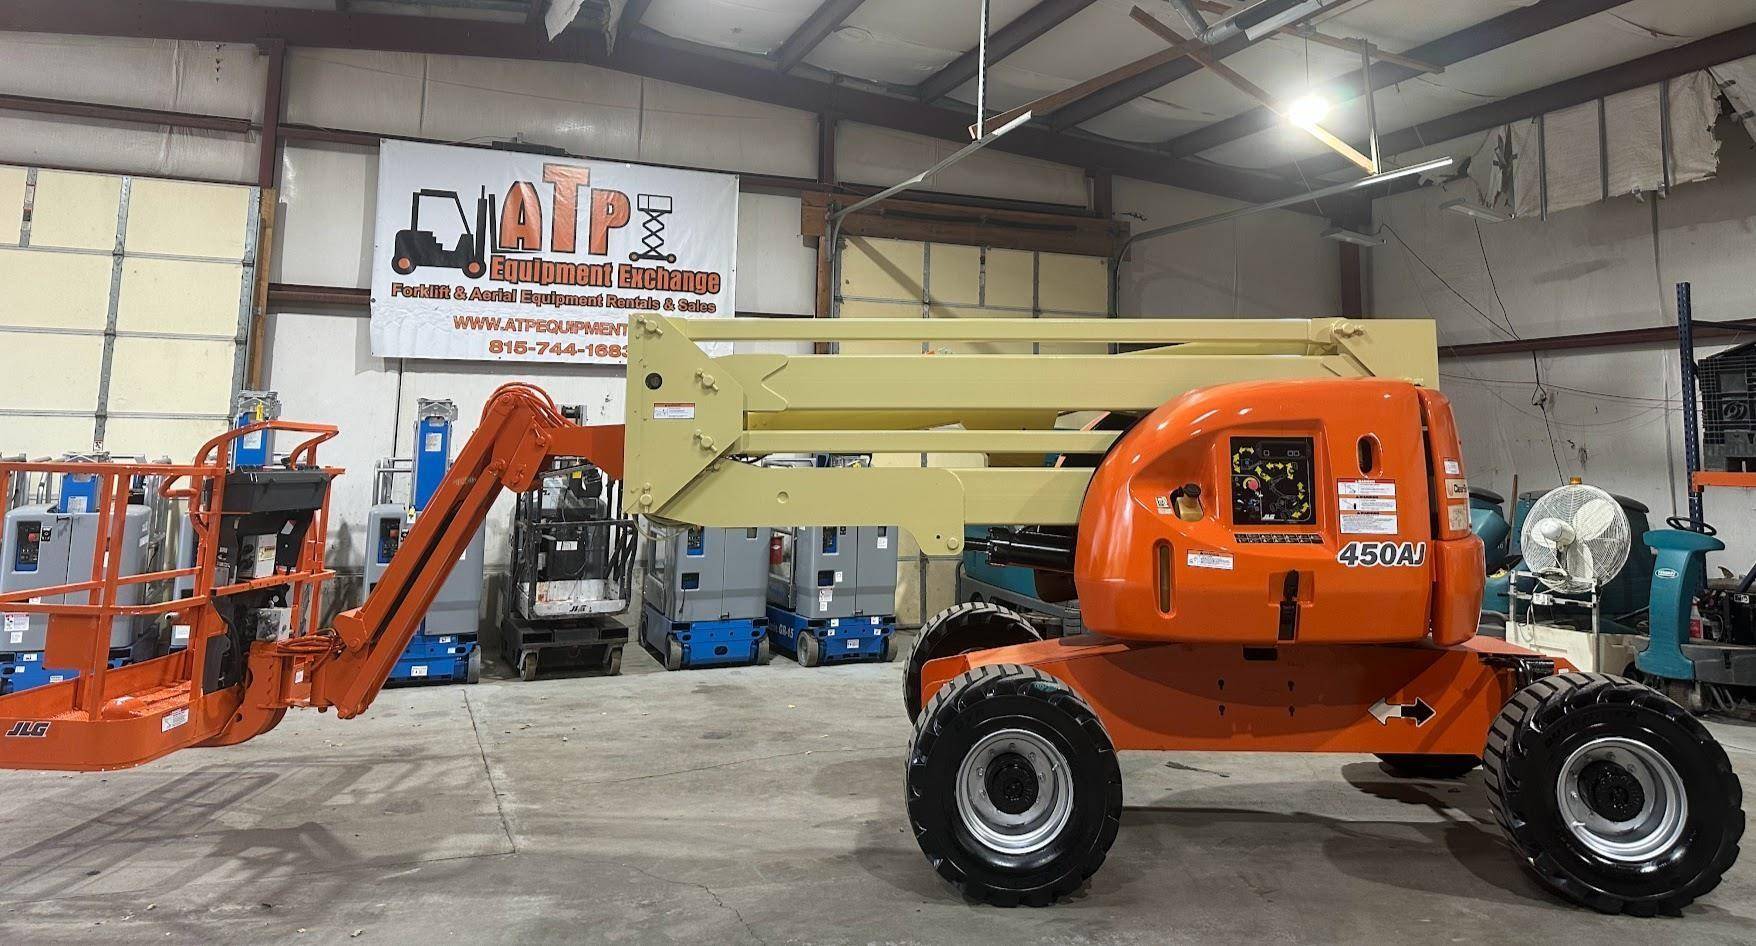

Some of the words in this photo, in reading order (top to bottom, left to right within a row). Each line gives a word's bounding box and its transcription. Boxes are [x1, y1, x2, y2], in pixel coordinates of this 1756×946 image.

[499, 163, 631, 256] ATP
[489, 255, 613, 287] Equipment
[618, 263, 721, 295] Exchange
[391, 282, 451, 299] Forklift
[454, 286, 467, 300] &
[469, 287, 517, 303] Aerial
[520, 289, 603, 307] Equipment
[606, 294, 660, 310] Rentals
[663, 298, 675, 312] &
[678, 299, 717, 313] Sales
[1338, 542, 1426, 566] 450AJ
[6, 721, 51, 737] JLG
